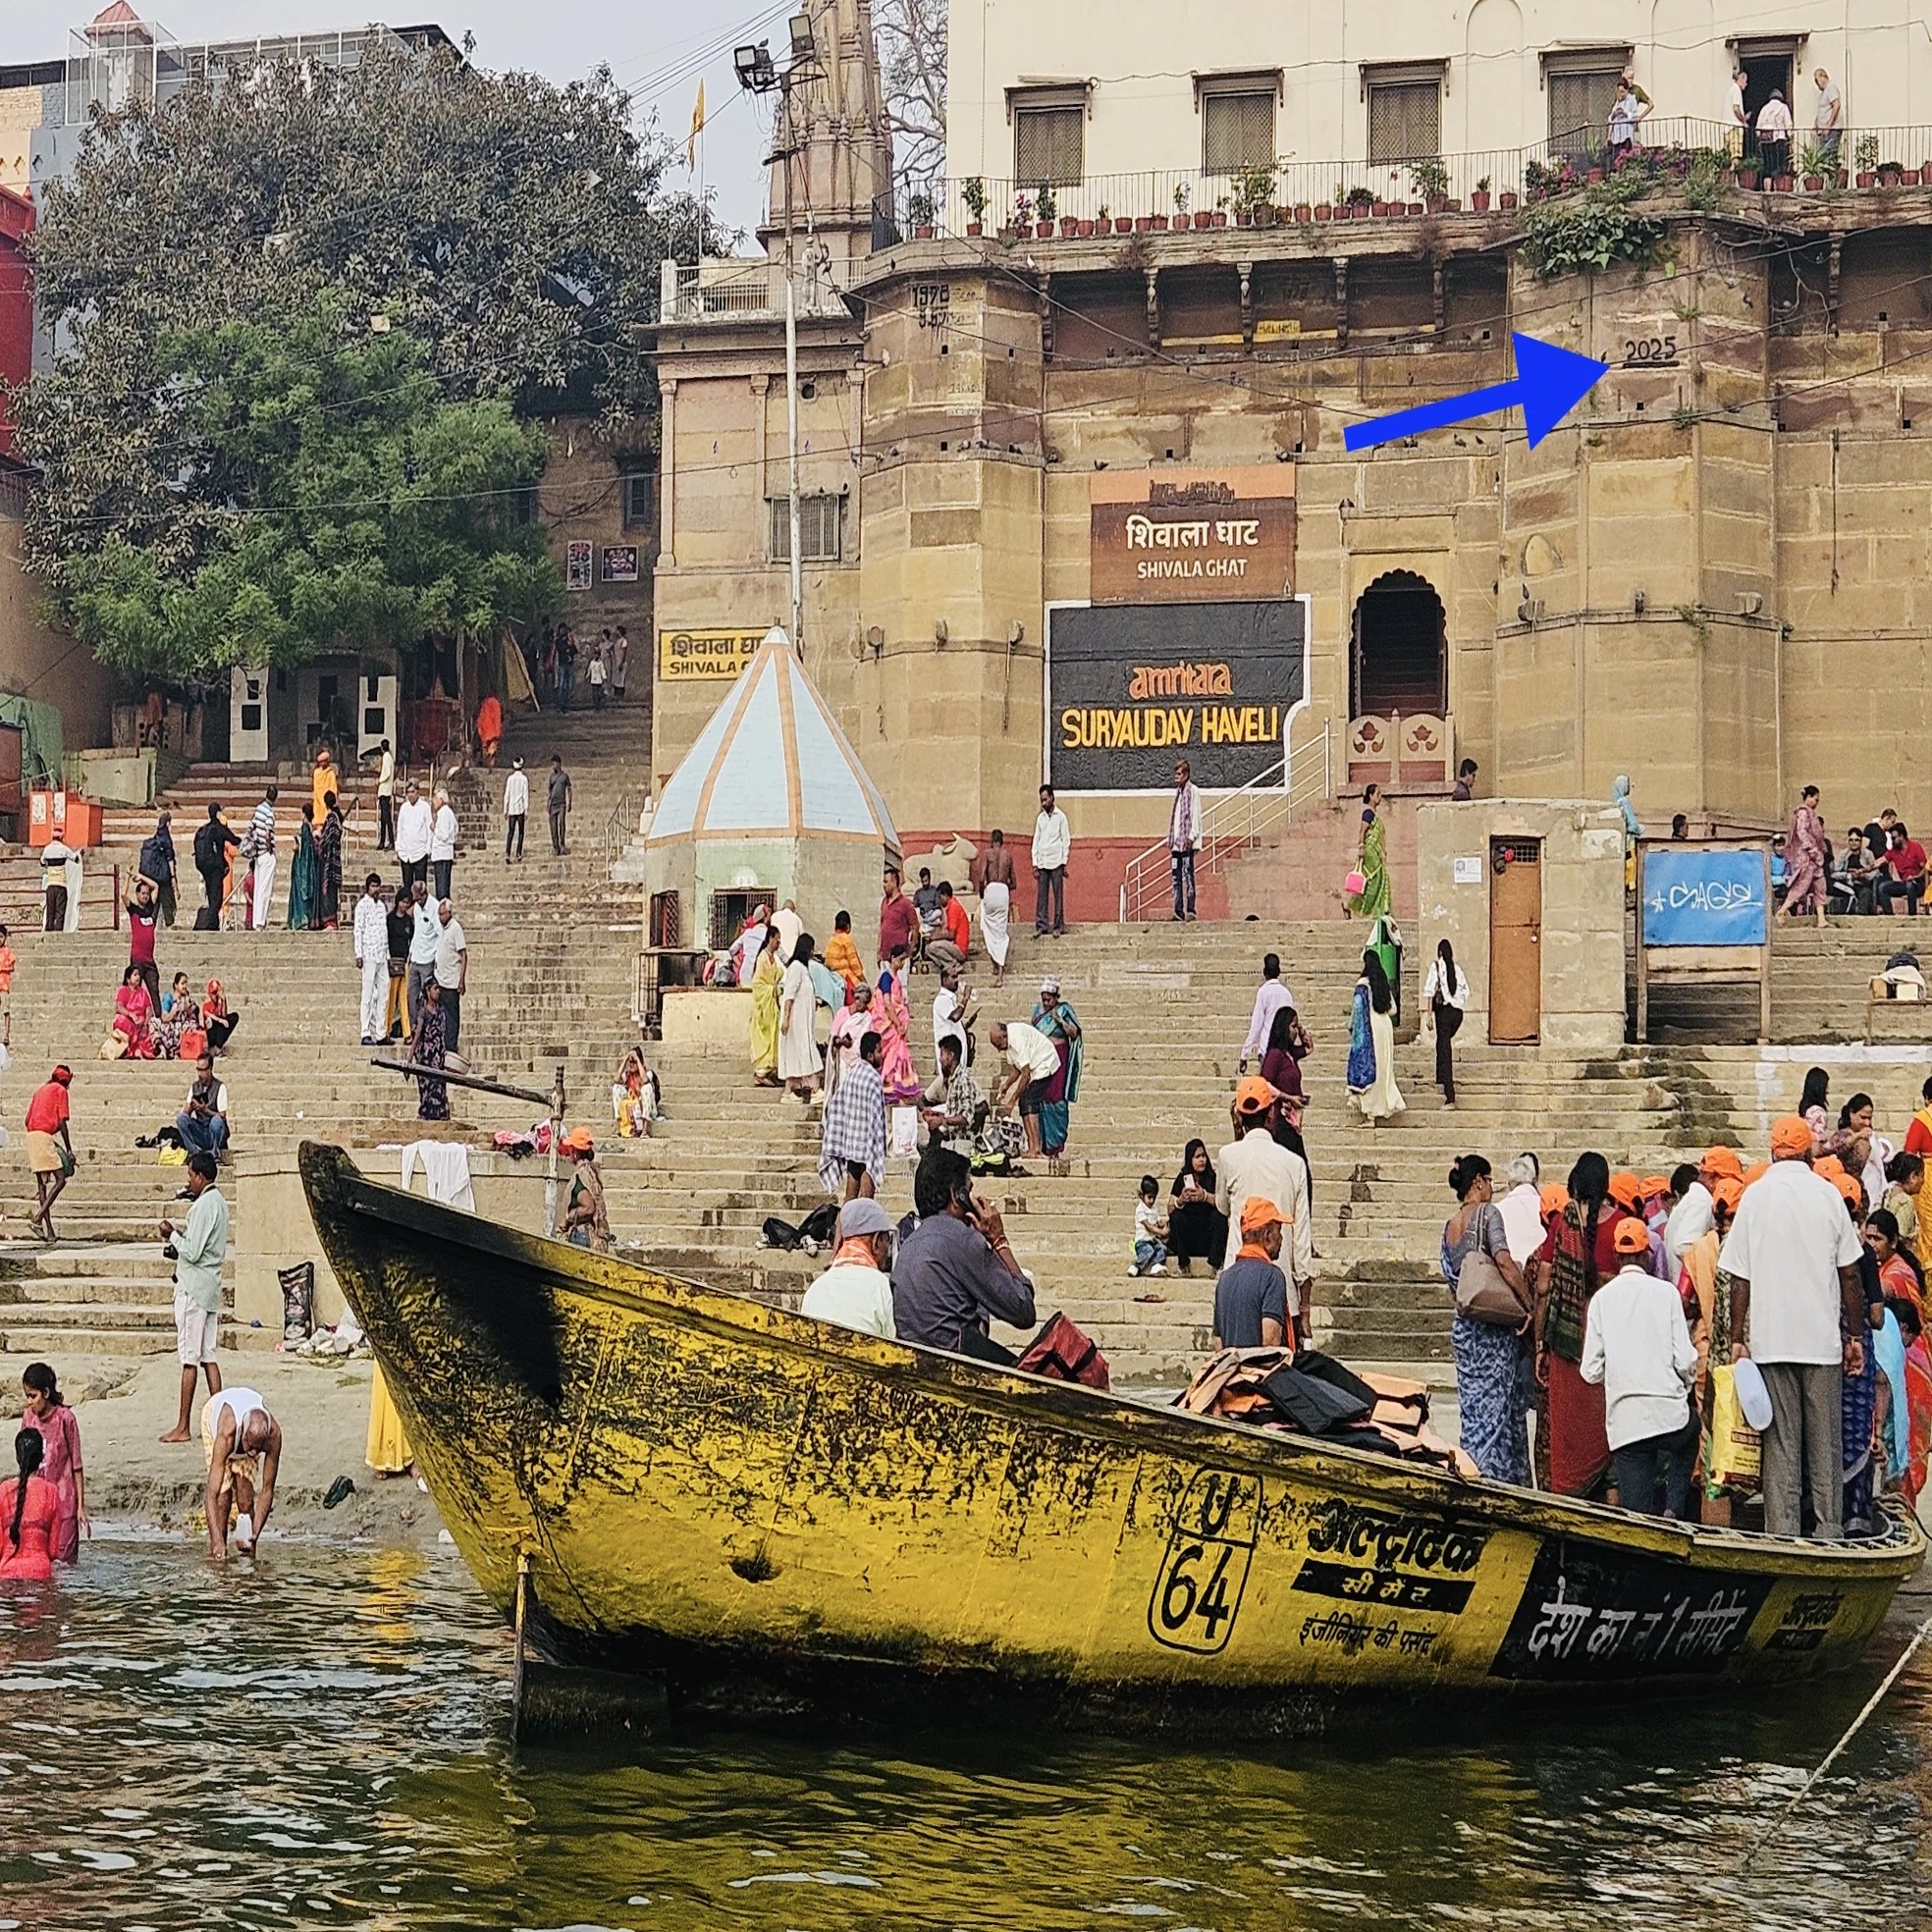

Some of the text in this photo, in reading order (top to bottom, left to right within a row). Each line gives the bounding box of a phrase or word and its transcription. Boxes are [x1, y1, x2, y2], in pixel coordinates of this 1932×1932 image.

[1625, 336, 1676, 361] 2025
[1126, 513, 1260, 550] शिवाला घाट
[1137, 559, 1248, 579] SHIVALA GHAT
[670, 633, 766, 658] शिवाला घा
[669, 661, 736, 674] SHIVALA
[1129, 660, 1234, 700] amritara
[1061, 706, 1279, 748] SURYAUDAY HAVELI
[1161, 1544, 1232, 1639] 64
[1374, 1620, 1399, 1649] की
[1585, 1608, 1637, 1662] का
